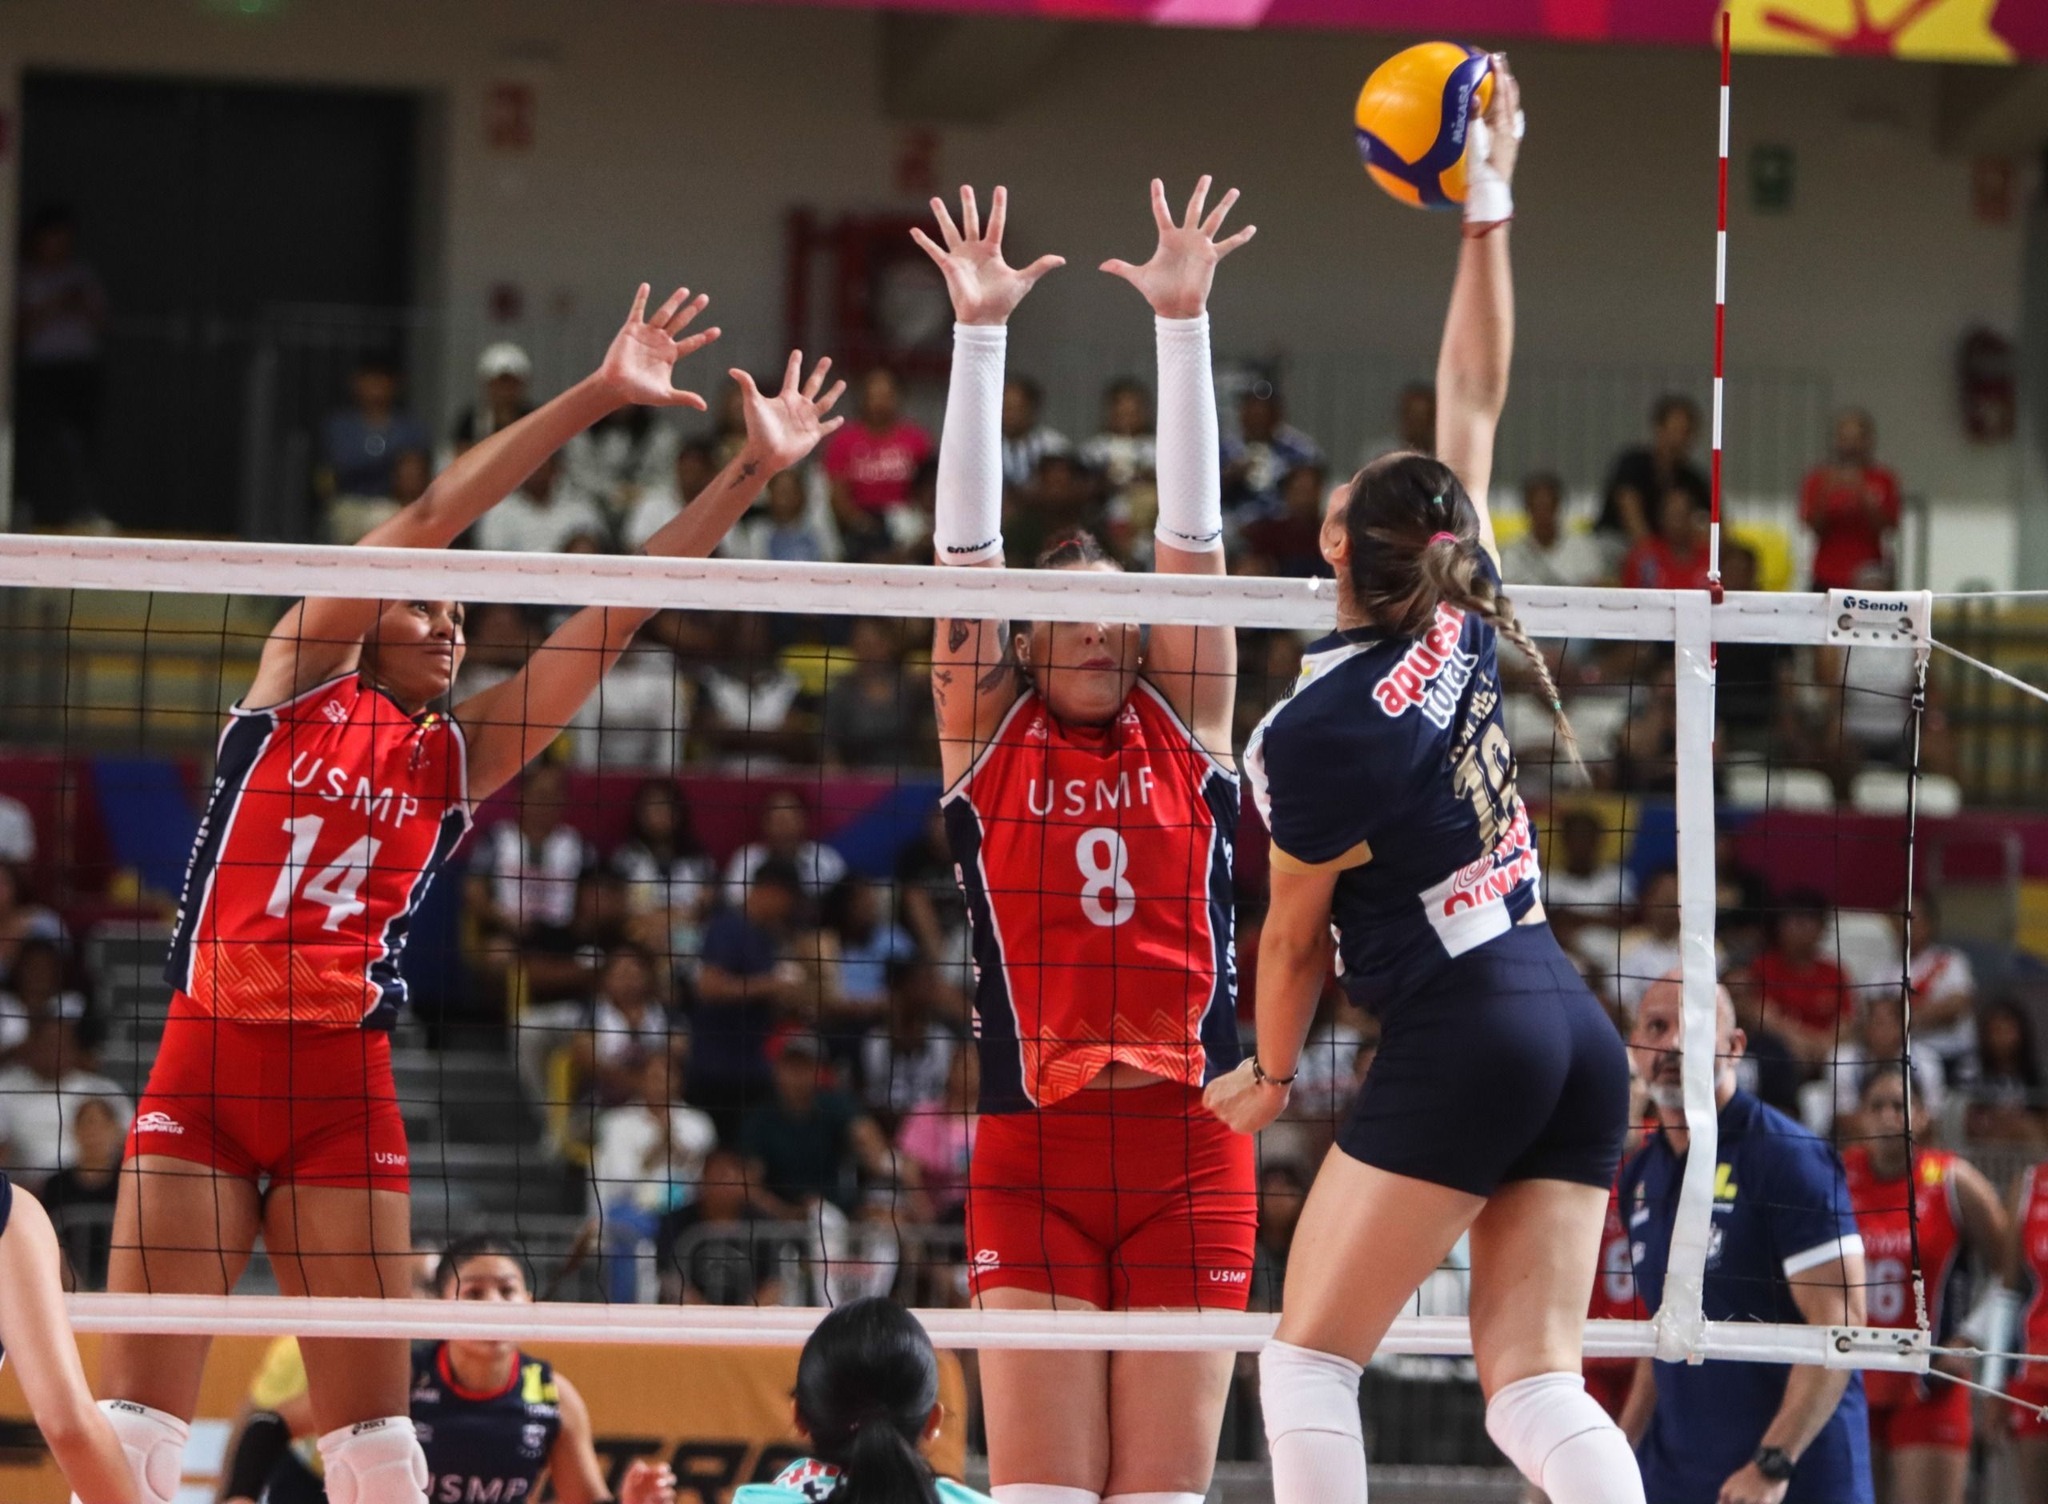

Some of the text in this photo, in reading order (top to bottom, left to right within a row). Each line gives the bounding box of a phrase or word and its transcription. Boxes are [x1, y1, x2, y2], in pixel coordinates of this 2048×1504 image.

[1858, 599, 1908, 612] Senoh
[287, 751, 418, 828] USMP
[265, 814, 382, 931] 14
[1076, 827, 1136, 927] 8
[375, 1152, 407, 1167] USMP
[1210, 1270, 1246, 1283] USMP
